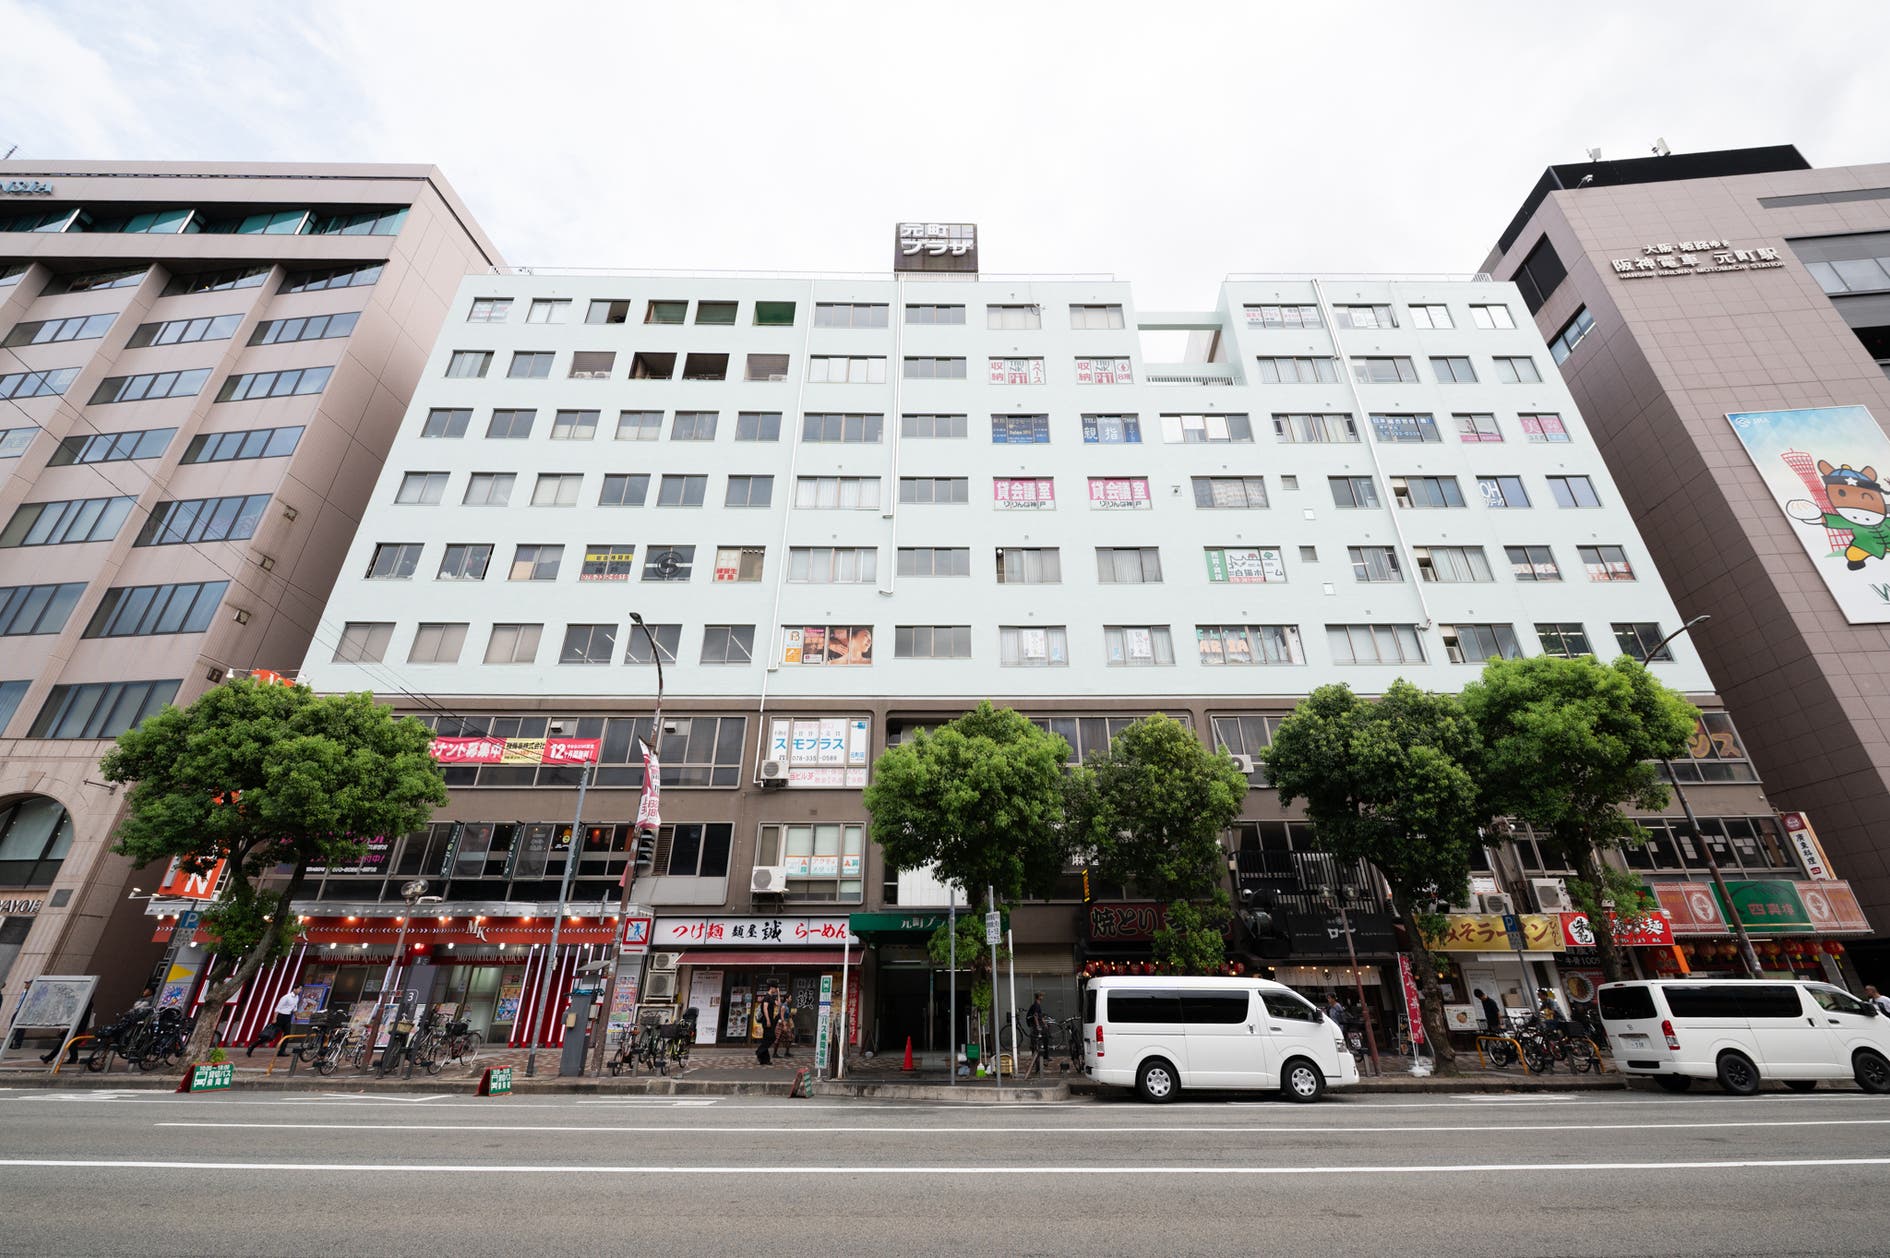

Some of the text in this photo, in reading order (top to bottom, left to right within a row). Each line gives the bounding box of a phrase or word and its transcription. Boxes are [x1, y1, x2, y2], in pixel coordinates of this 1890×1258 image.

[901, 239, 974, 256] プラザ
[1611, 246, 1781, 273] 阪神電車 元町駅
[1657, 267, 1694, 276] RAILWAY
[1695, 263, 1749, 274] MOTOMACHI
[1750, 259, 1787, 268] STATION
[185, 912, 198, 927] P
[1091, 906, 1159, 937] 焼とり
[1505, 917, 1514, 930] P
[672, 922, 725, 941] つけ麺
[795, 922, 847, 939] らーめん
